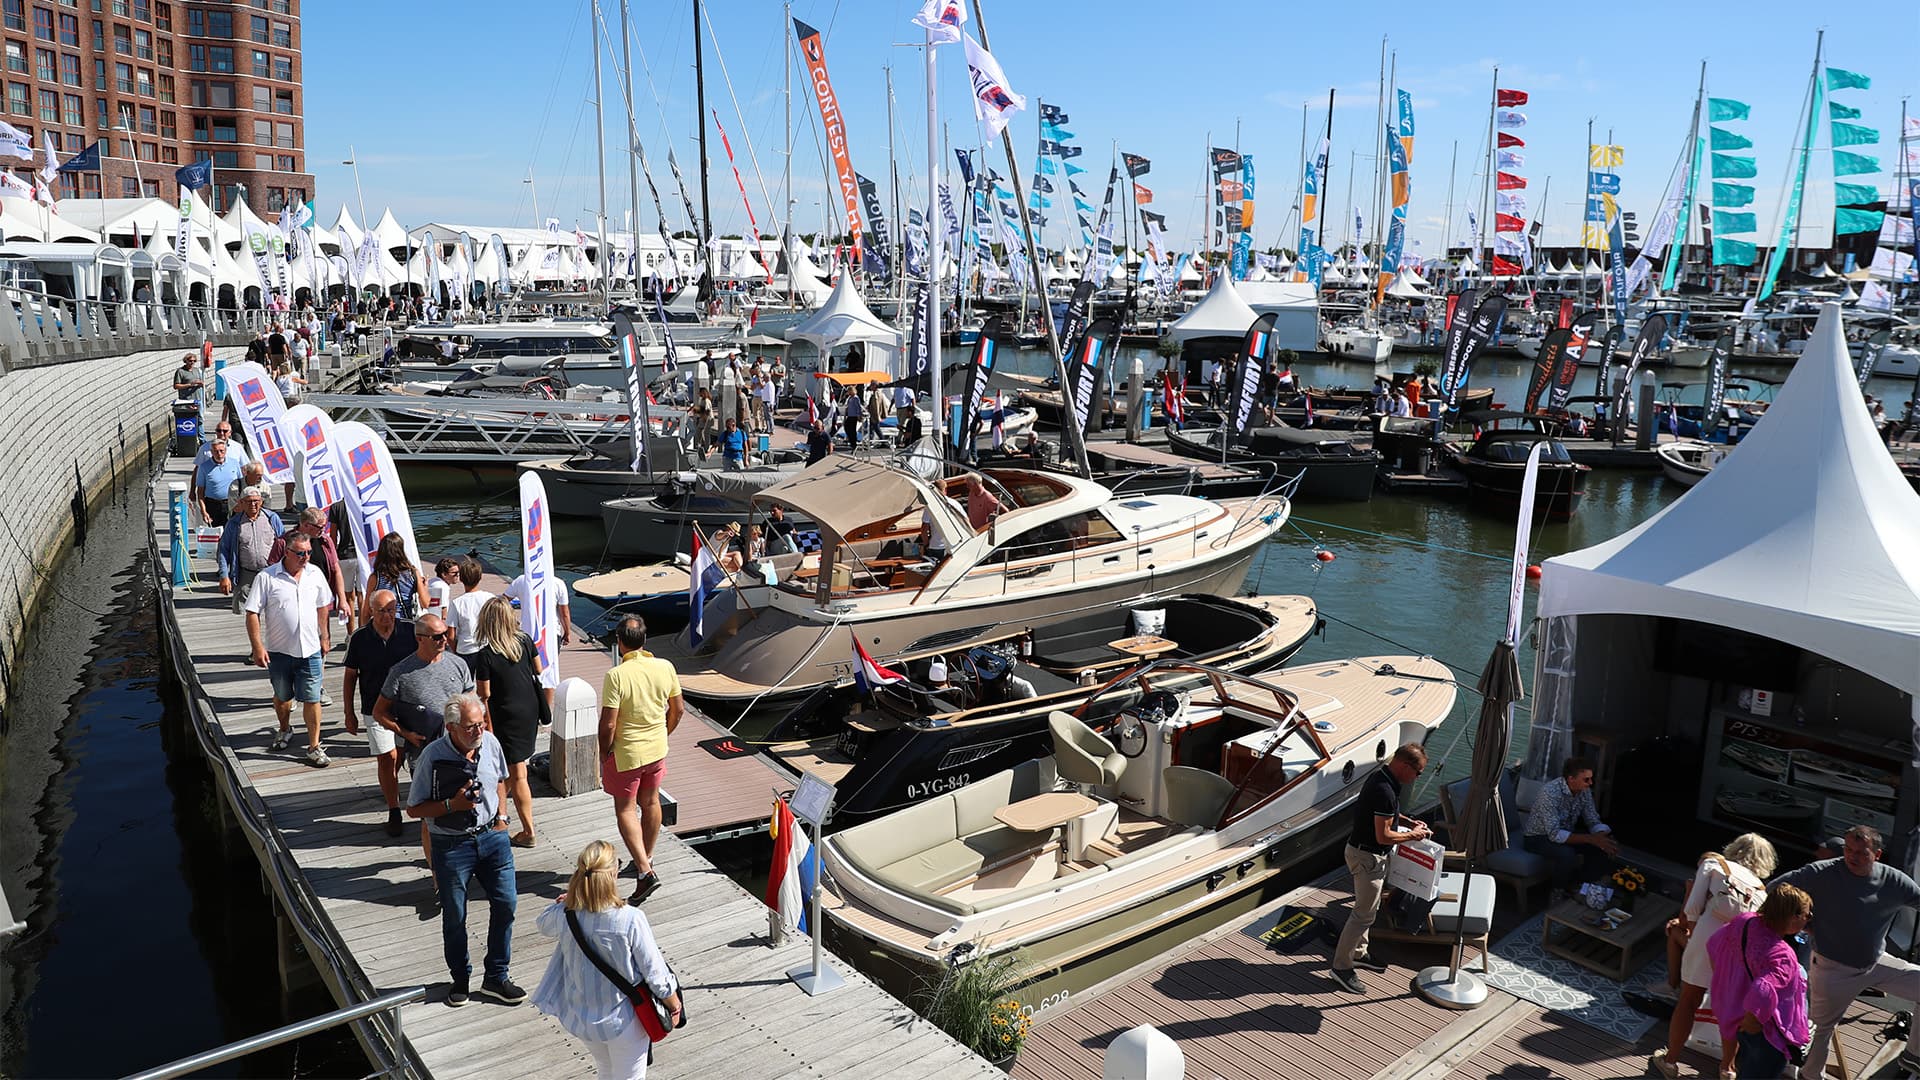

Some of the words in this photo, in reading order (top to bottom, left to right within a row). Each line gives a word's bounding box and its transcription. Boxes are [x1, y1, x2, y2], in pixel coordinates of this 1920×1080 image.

[812, 67, 848, 160] CONTEST
[1613, 252, 1626, 299] DUFOUR
[916, 288, 932, 395] INTERBO
[1062, 318, 1077, 358] RSPOOR
[1445, 329, 1462, 391] WATERSPOOR
[1566, 324, 1592, 359] AVR
[1075, 362, 1096, 435] AFURY
[1235, 360, 1265, 433] SEAFURY
[1449, 338, 1478, 405] WATERSPOOR
[1729, 721, 1761, 737] PTS
[907, 773, 971, 799] 0-YG-842
